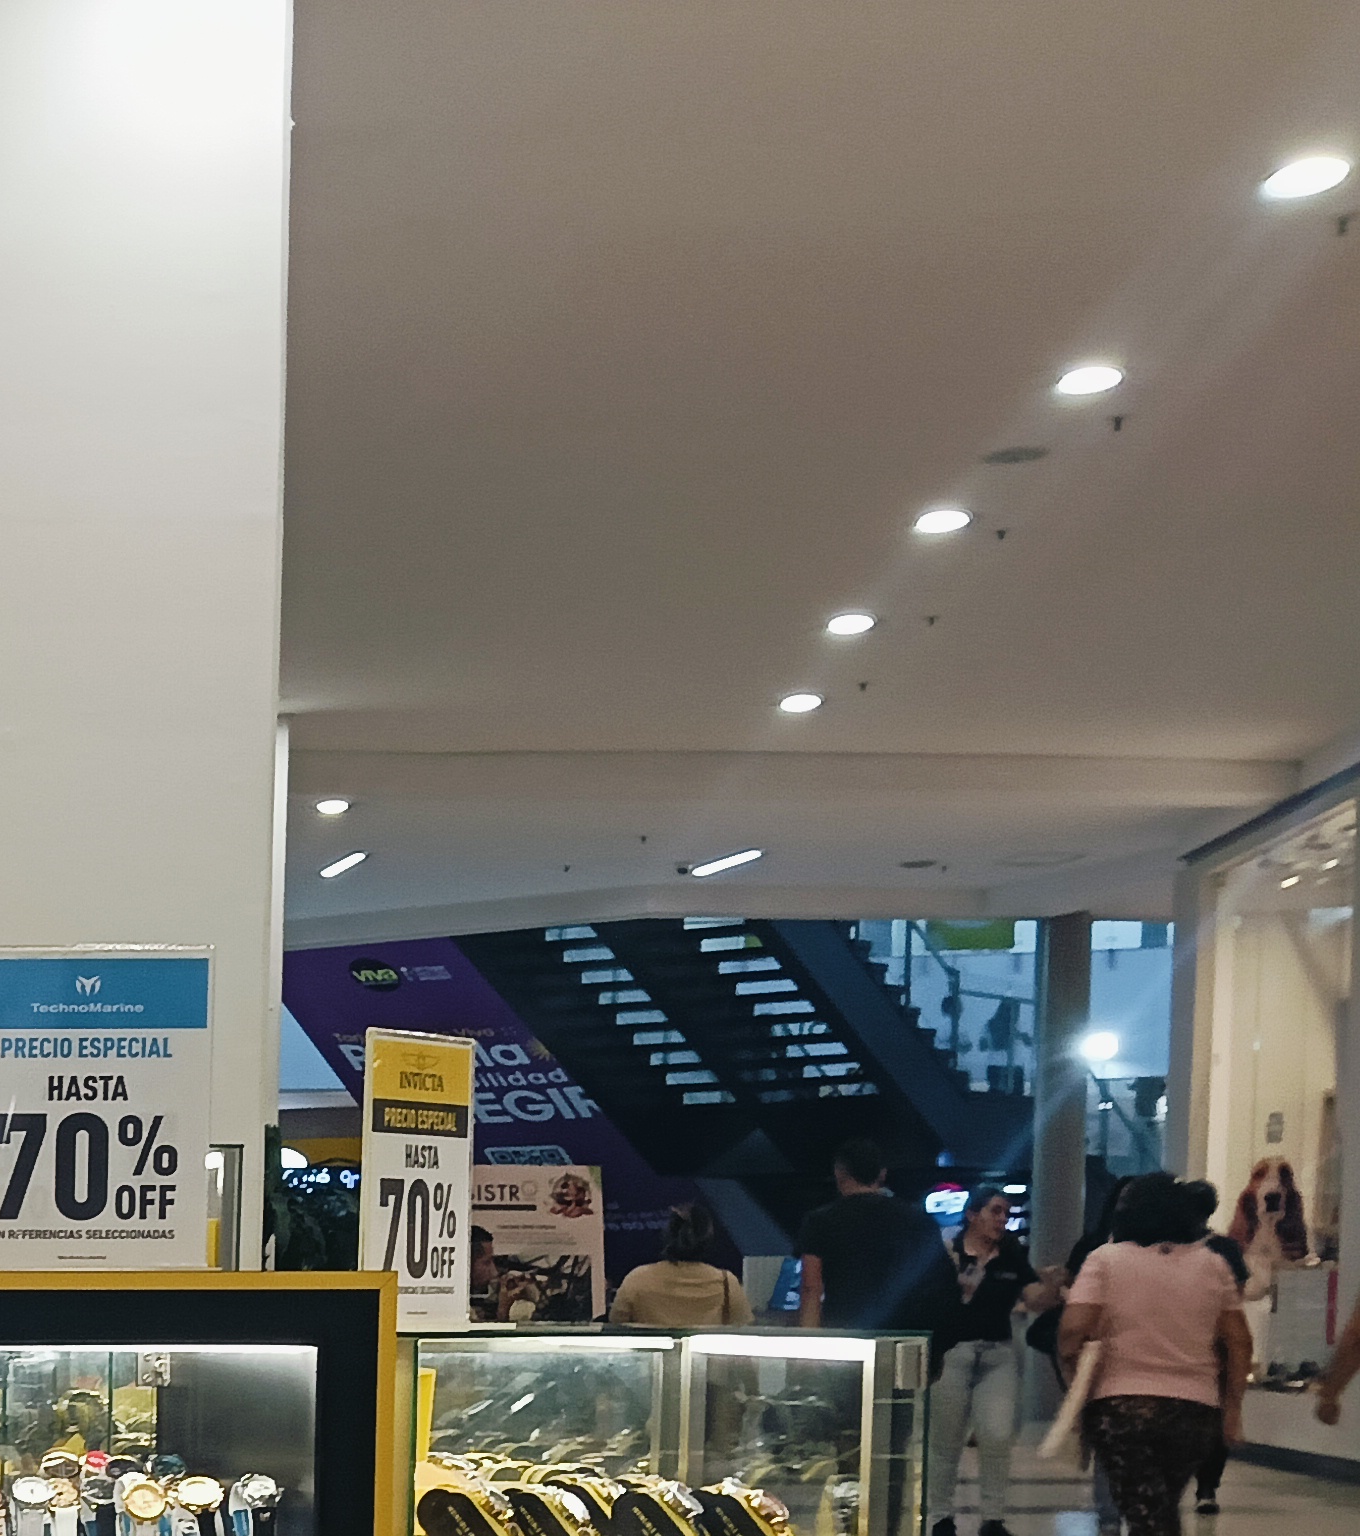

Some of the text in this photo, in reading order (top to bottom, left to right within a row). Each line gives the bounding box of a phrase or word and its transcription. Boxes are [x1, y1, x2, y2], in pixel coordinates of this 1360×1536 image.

[30, 1003, 144, 1013] TechnoMarine
[0, 1037, 172, 1058] PRECIO ESPECIAL
[48, 1075, 128, 1101] HASTA
[400, 1071, 444, 1092] INVICTA
[384, 1107, 457, 1131] PRECIO ESPECIAL
[405, 1144, 439, 1169] HASTA
[115, 1184, 177, 1221] OFF
[85, 1229, 175, 1239] SELECCIONADAS
[380, 1178, 457, 1278] 70%
[431, 1246, 456, 1278] OFF
